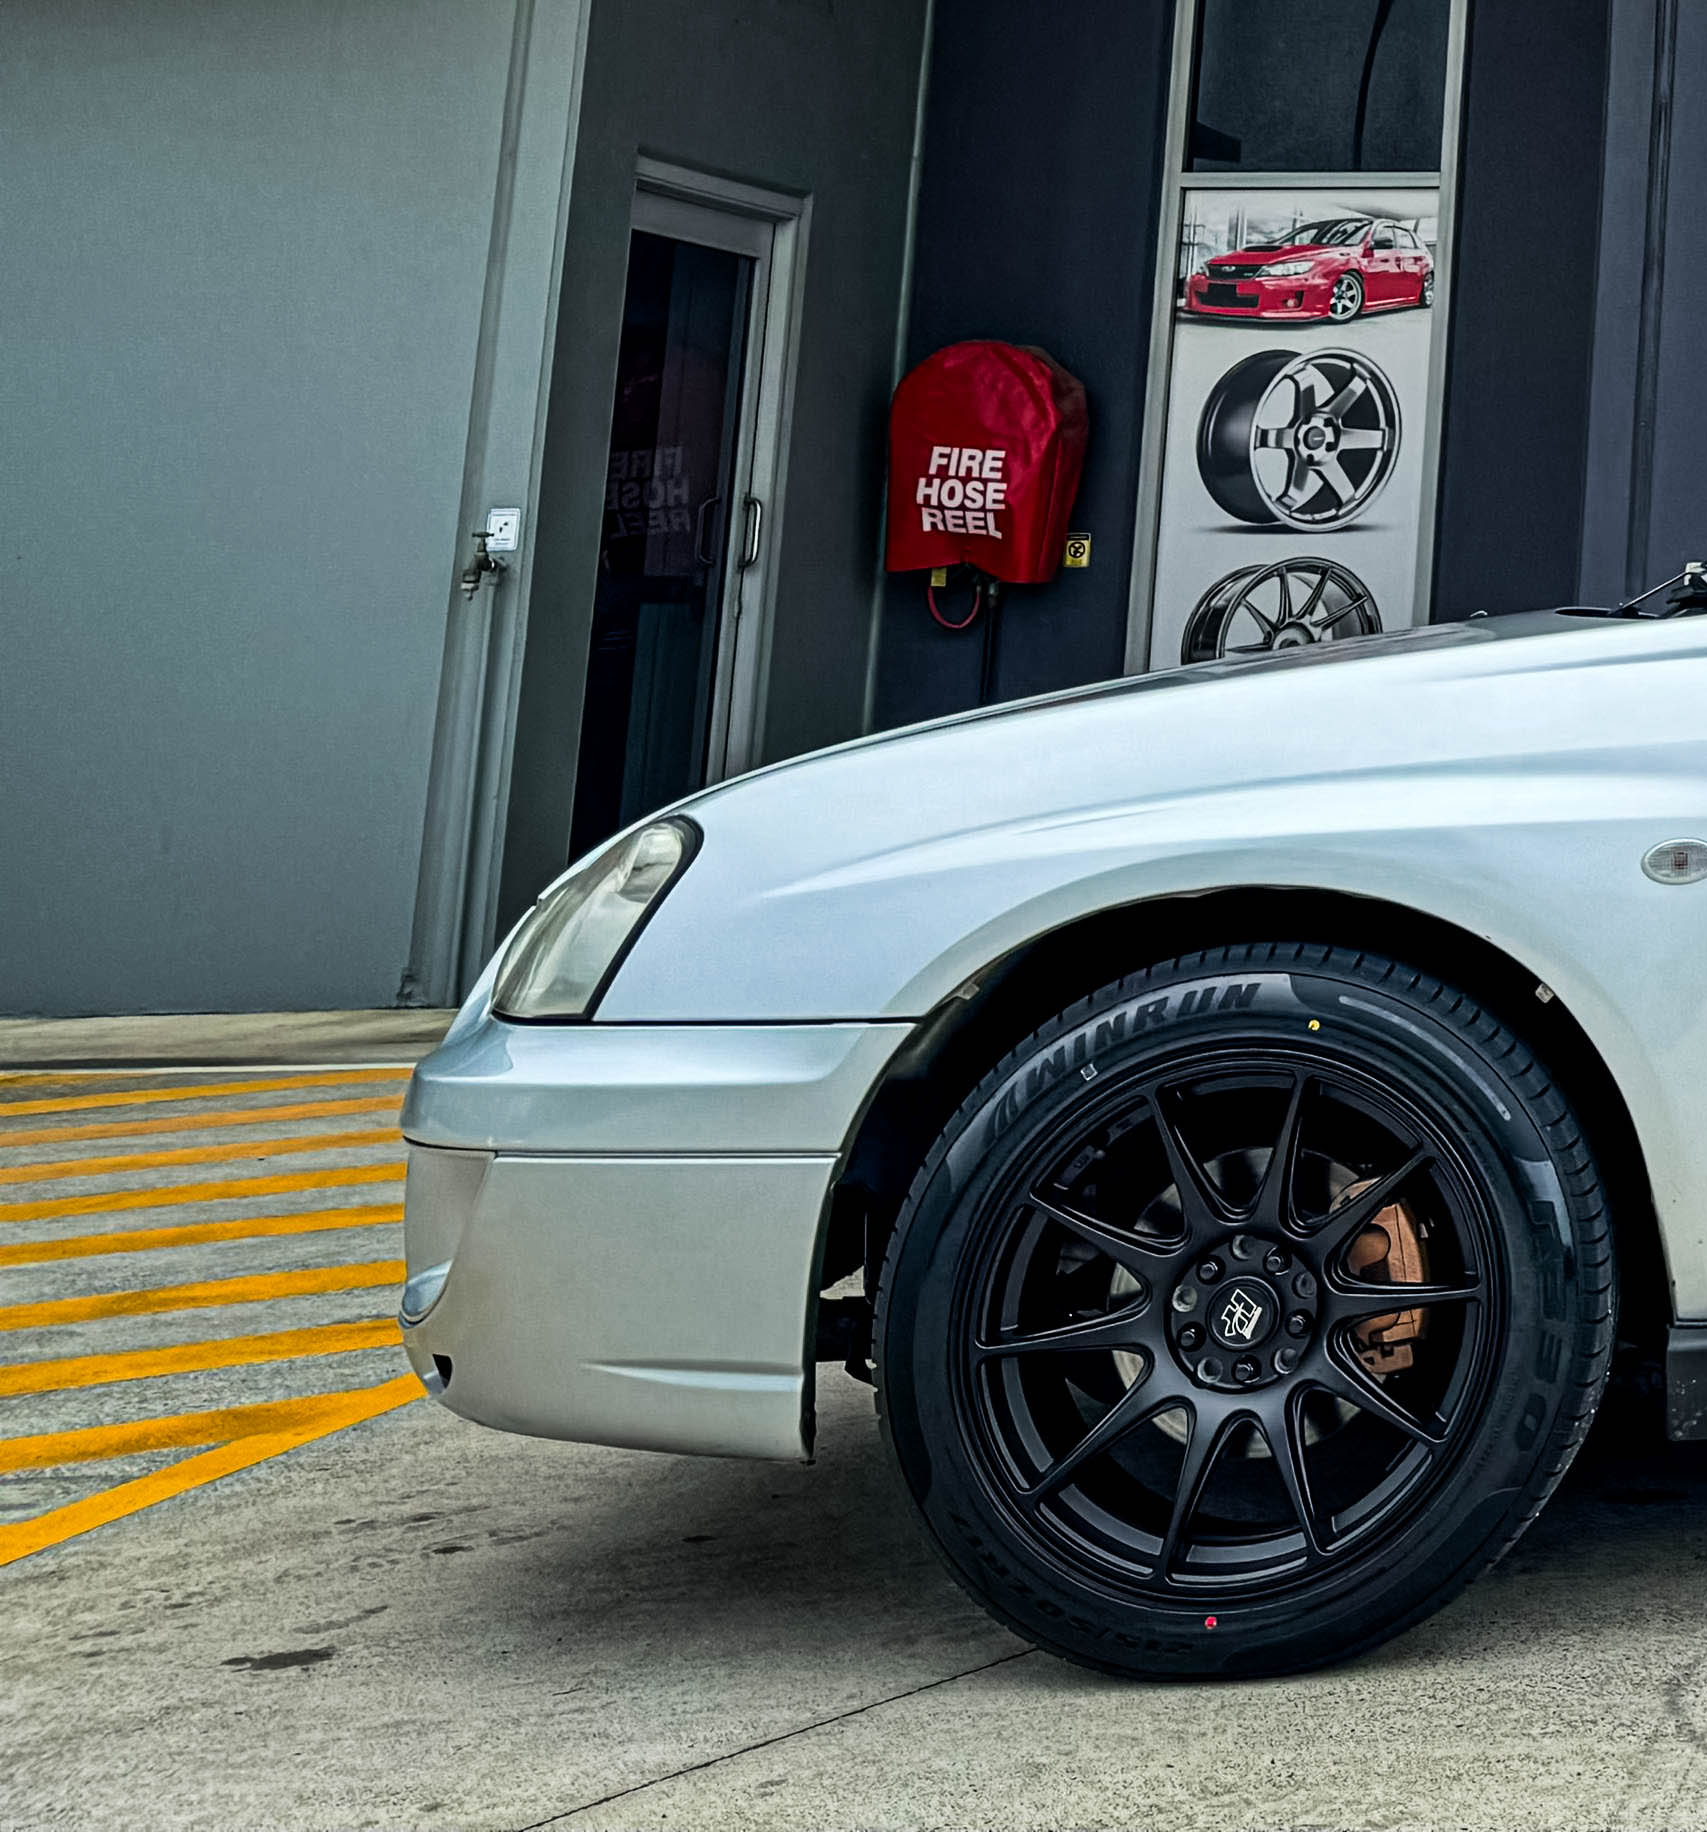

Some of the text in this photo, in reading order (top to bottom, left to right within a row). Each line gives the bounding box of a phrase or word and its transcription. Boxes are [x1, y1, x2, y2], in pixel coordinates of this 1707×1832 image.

[928, 445, 1006, 480] FIRE
[915, 477, 1008, 510] HOSE
[920, 507, 1003, 540] REEL
[1024, 982, 1262, 1098] WINRUN
